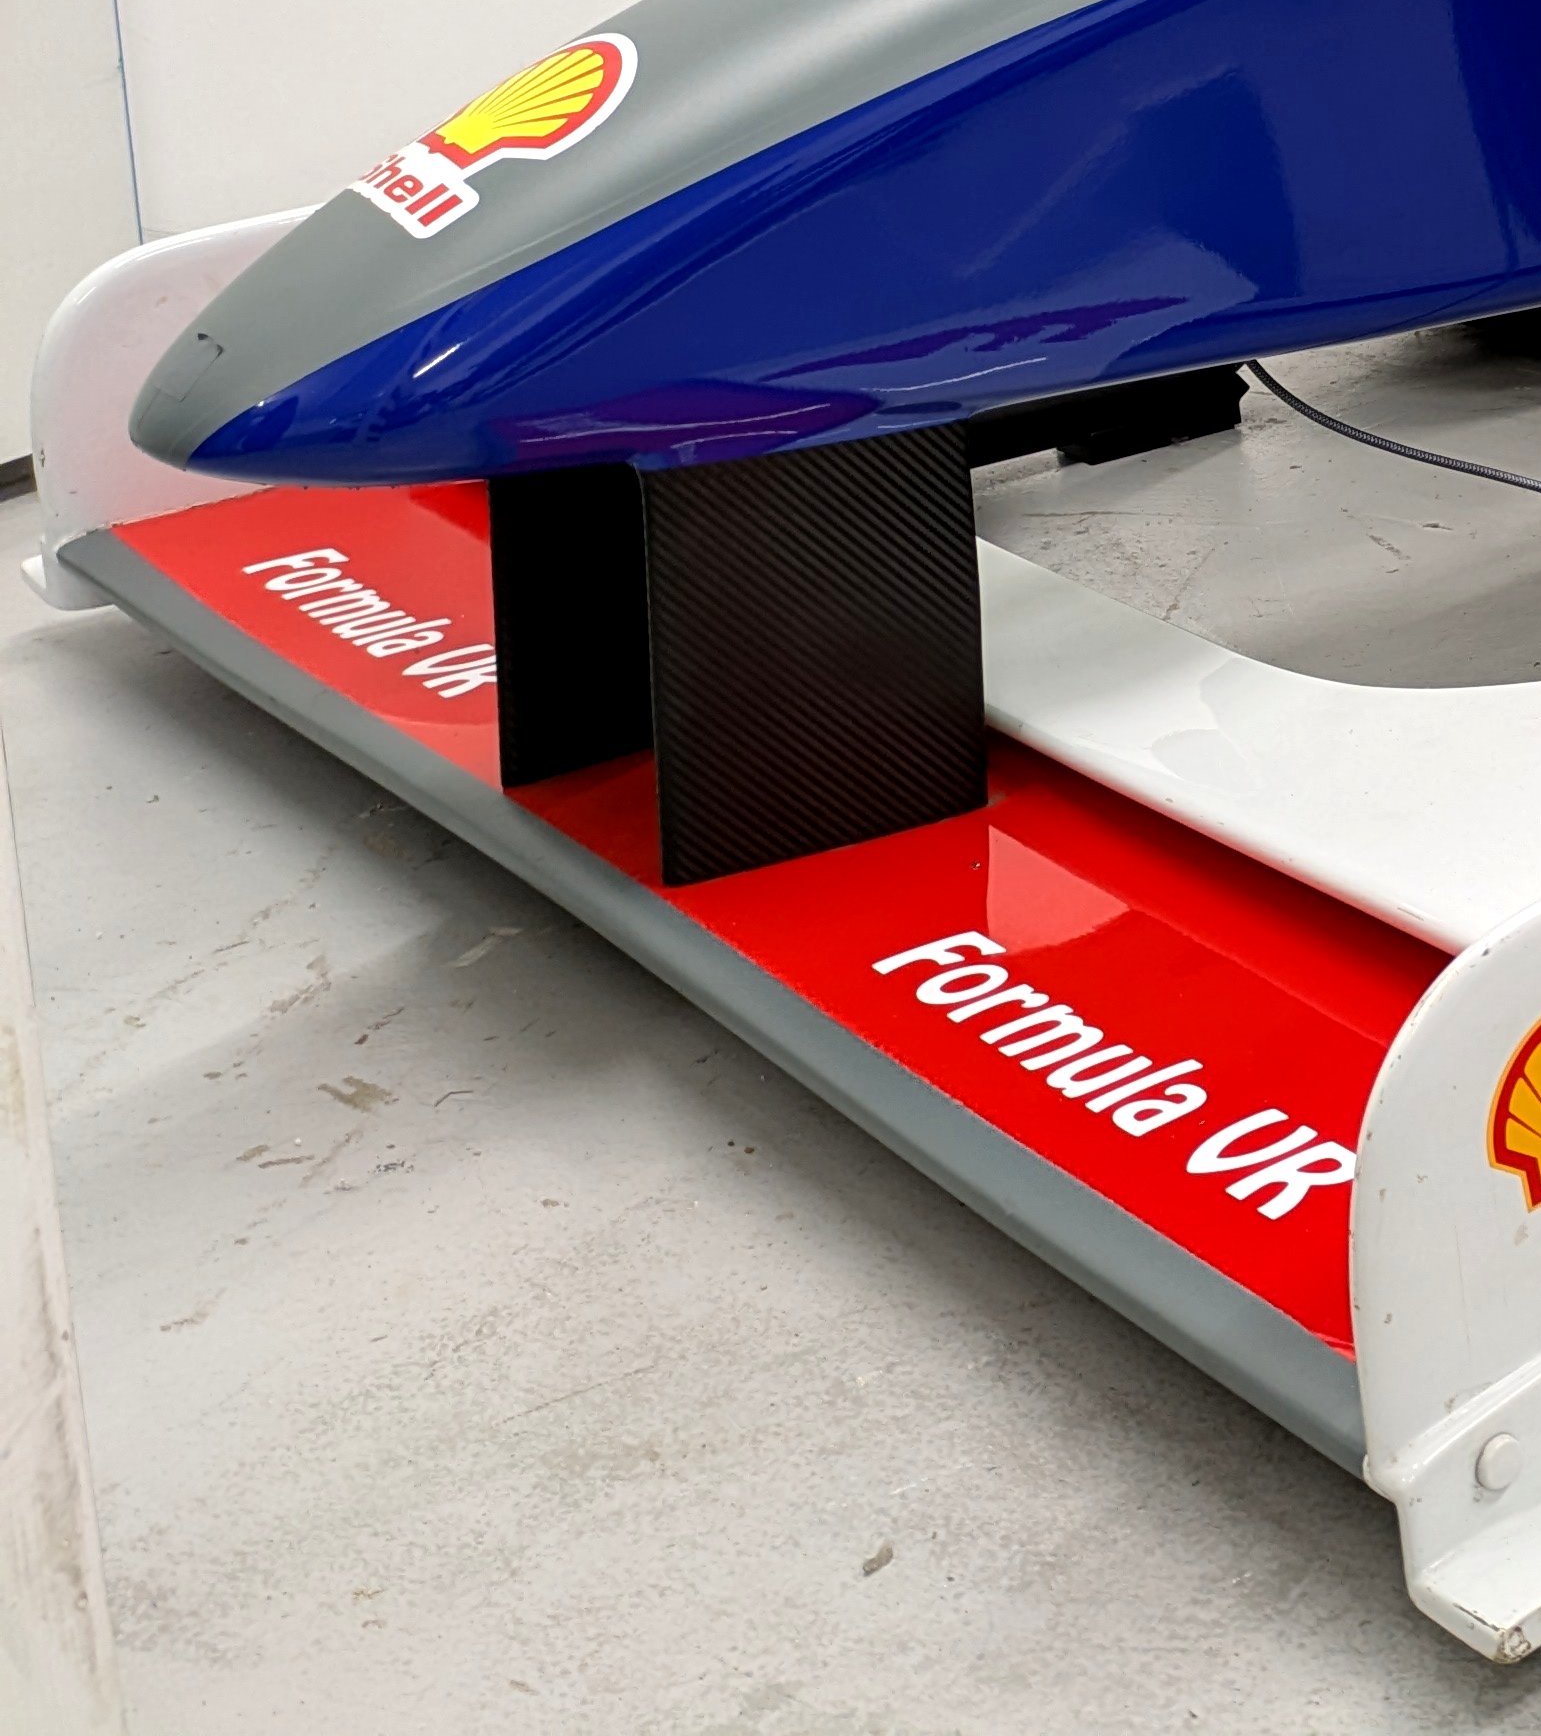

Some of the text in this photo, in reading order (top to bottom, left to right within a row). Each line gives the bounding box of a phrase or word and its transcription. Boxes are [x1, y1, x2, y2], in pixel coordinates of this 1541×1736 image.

[241, 547, 452, 658] Formula
[872, 931, 1357, 1220] Formula VR
